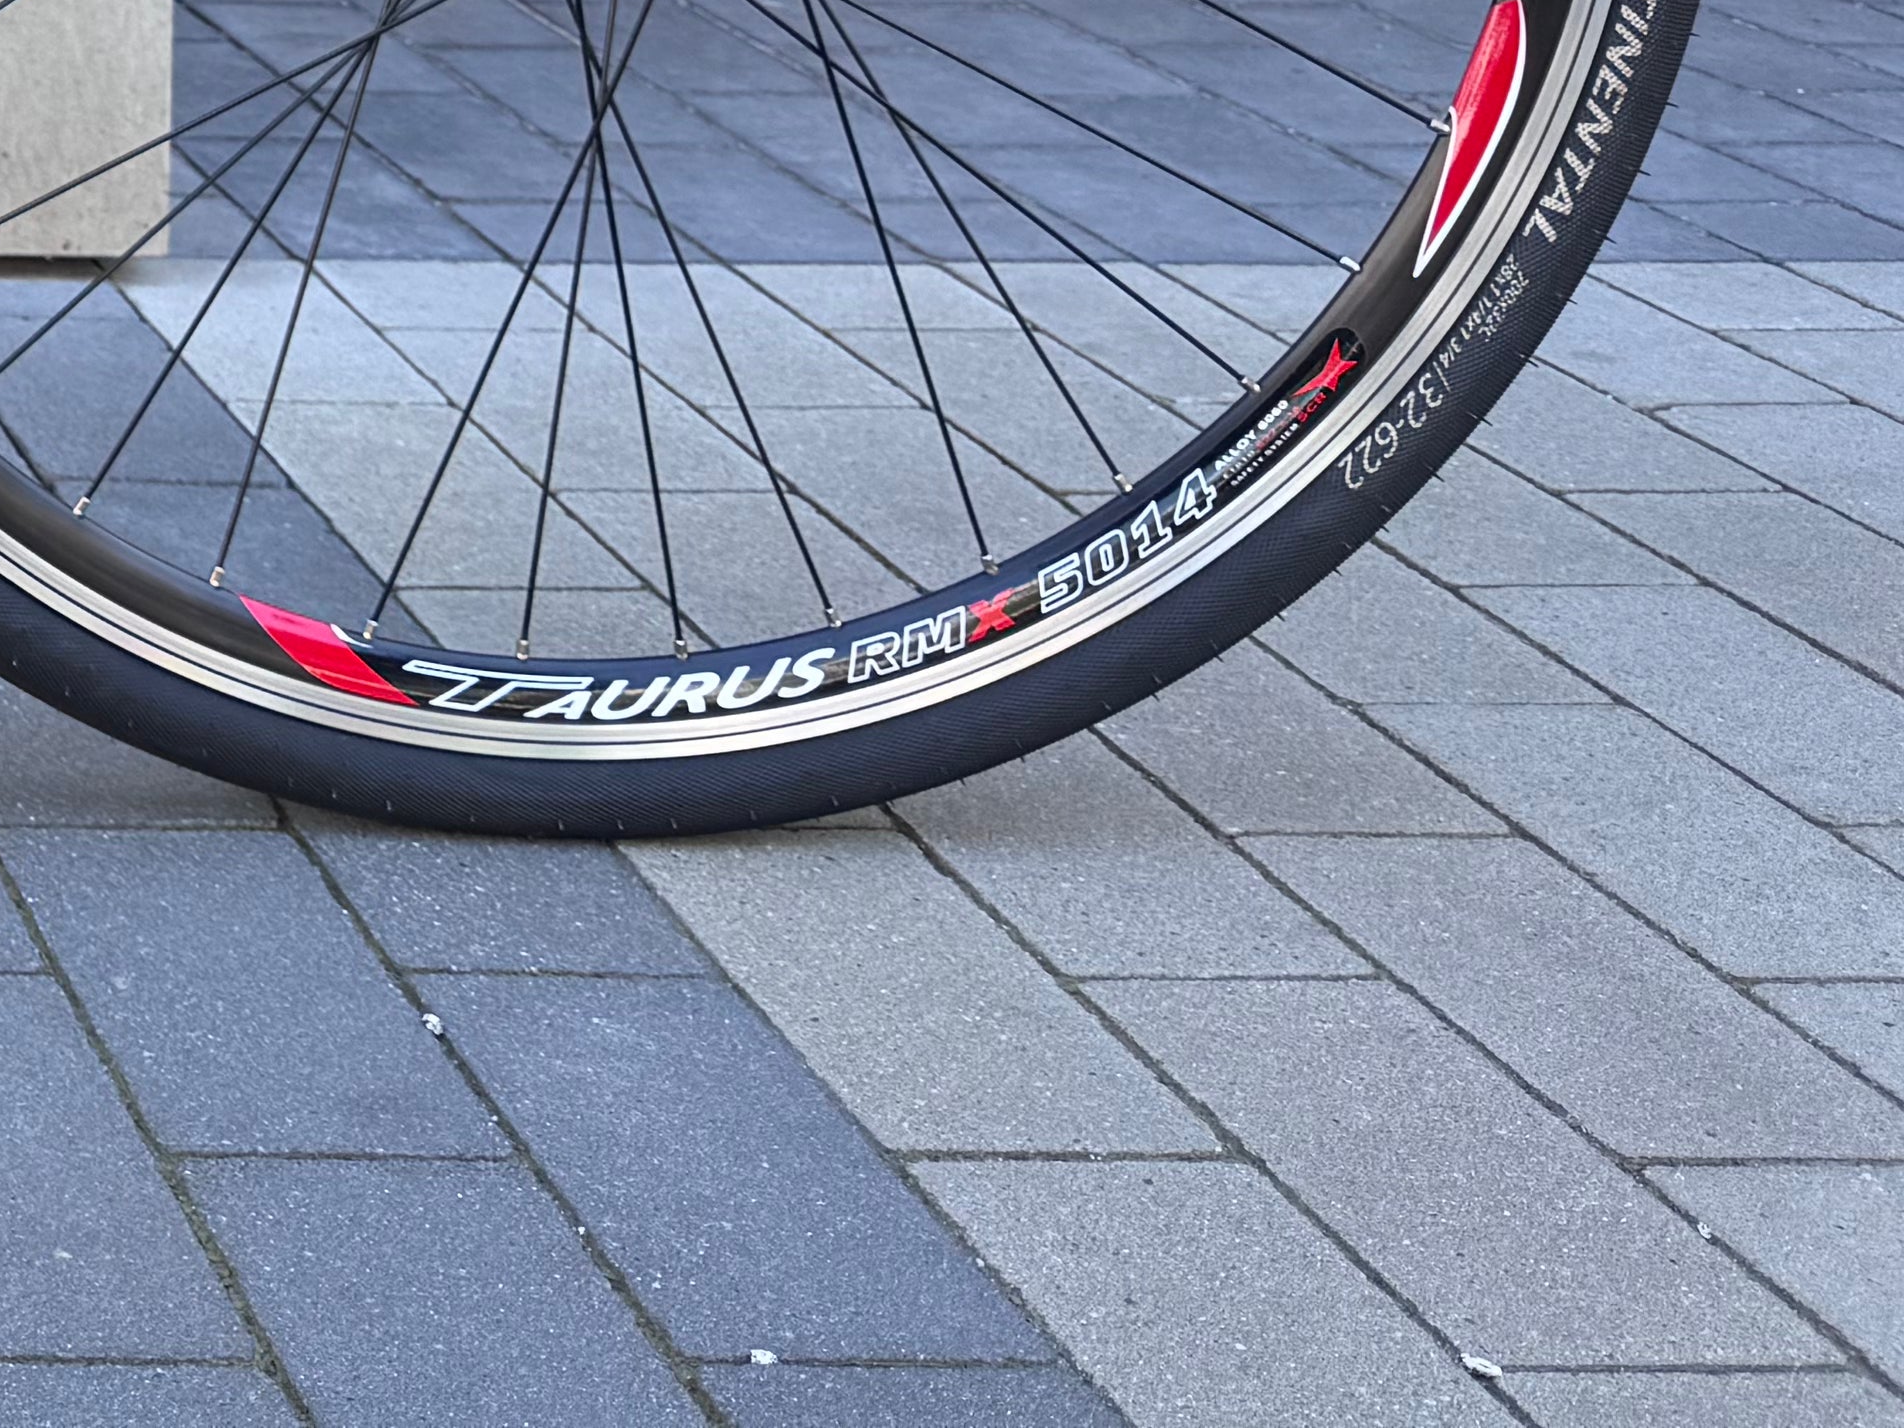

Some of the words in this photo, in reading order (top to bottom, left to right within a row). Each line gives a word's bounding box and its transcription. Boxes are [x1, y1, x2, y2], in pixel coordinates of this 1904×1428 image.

[1297, 392, 1327, 422] SCR
[1338, 372, 1444, 489] 32-622
[1214, 429, 1256, 472] ALLOY
[401, 646, 836, 722] TAURUS
[847, 587, 1016, 684] RMX
[1037, 467, 1217, 610] 5014
